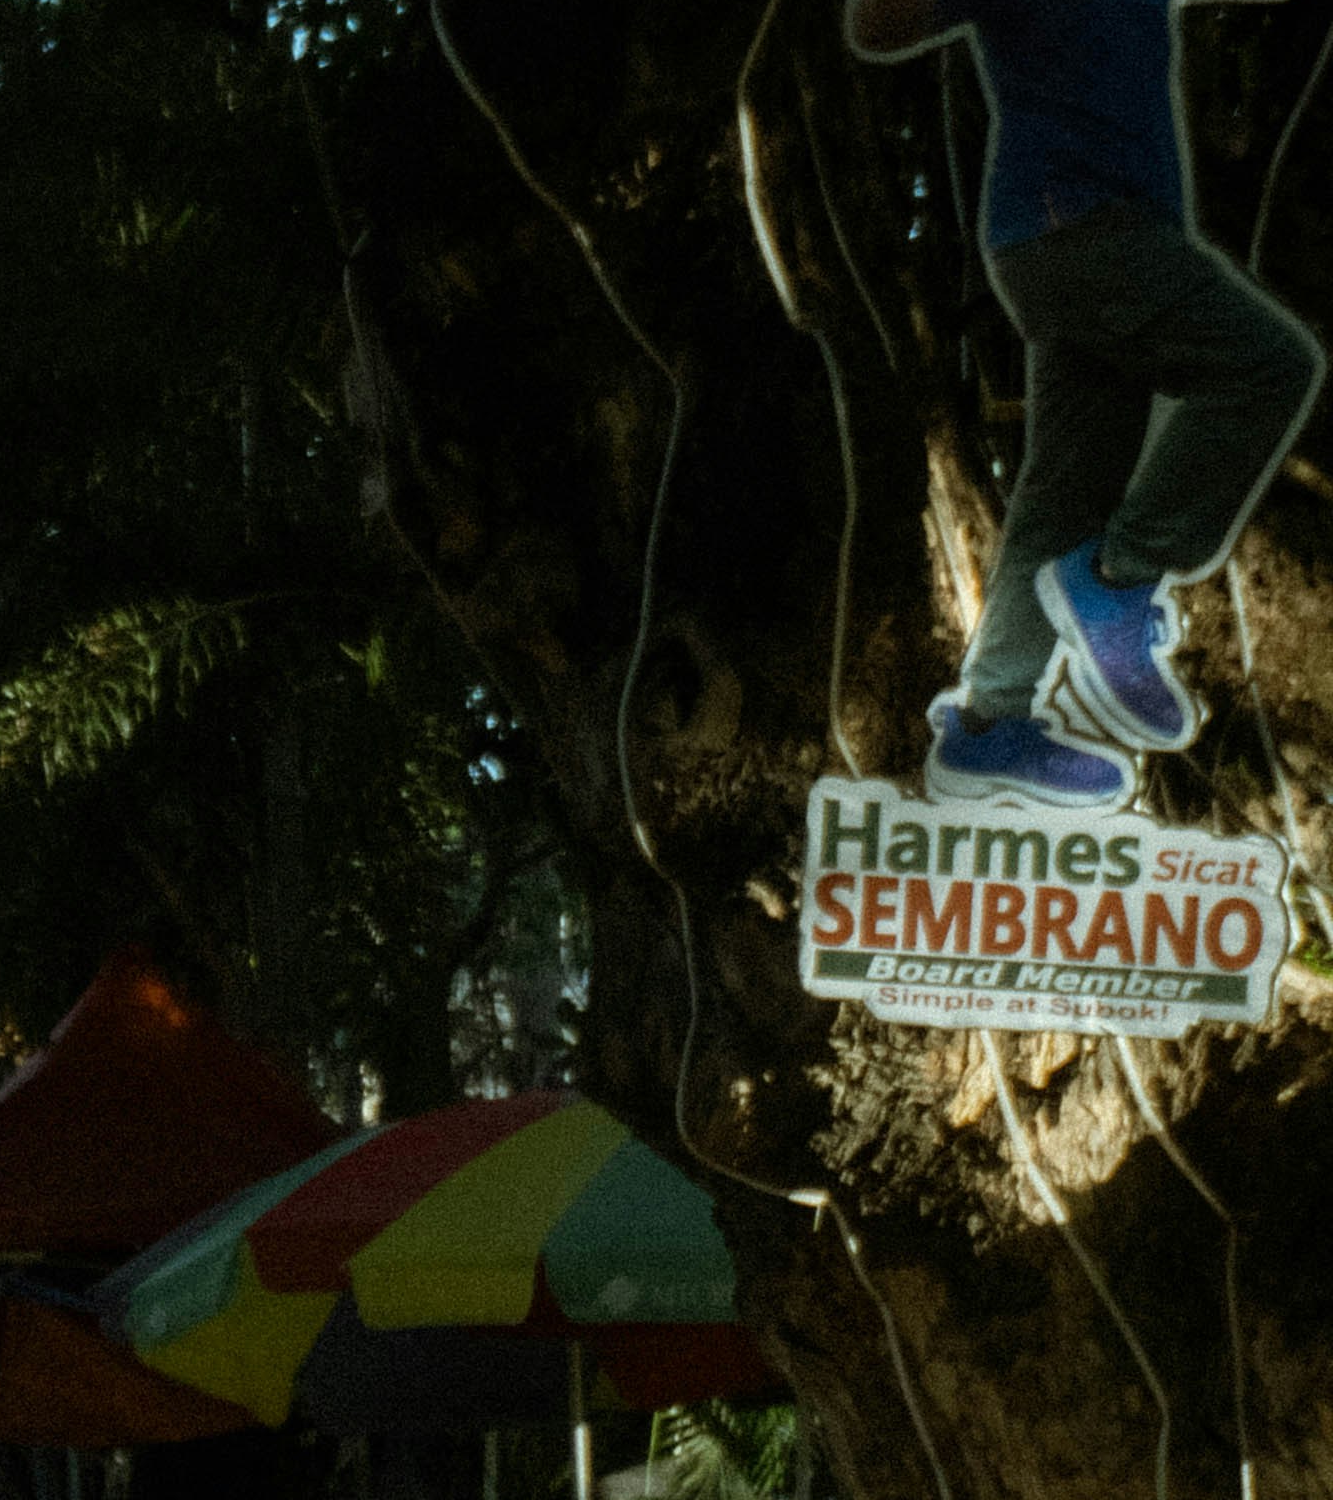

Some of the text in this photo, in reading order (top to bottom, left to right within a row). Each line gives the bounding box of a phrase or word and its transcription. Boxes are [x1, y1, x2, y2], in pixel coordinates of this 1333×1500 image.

[820, 799, 1261, 888] Harmes Sicat
[811, 872, 1264, 972] SEMBRANO
[866, 954, 1205, 1000] Board Member
[877, 987, 1170, 1022] Simple at Subok!
